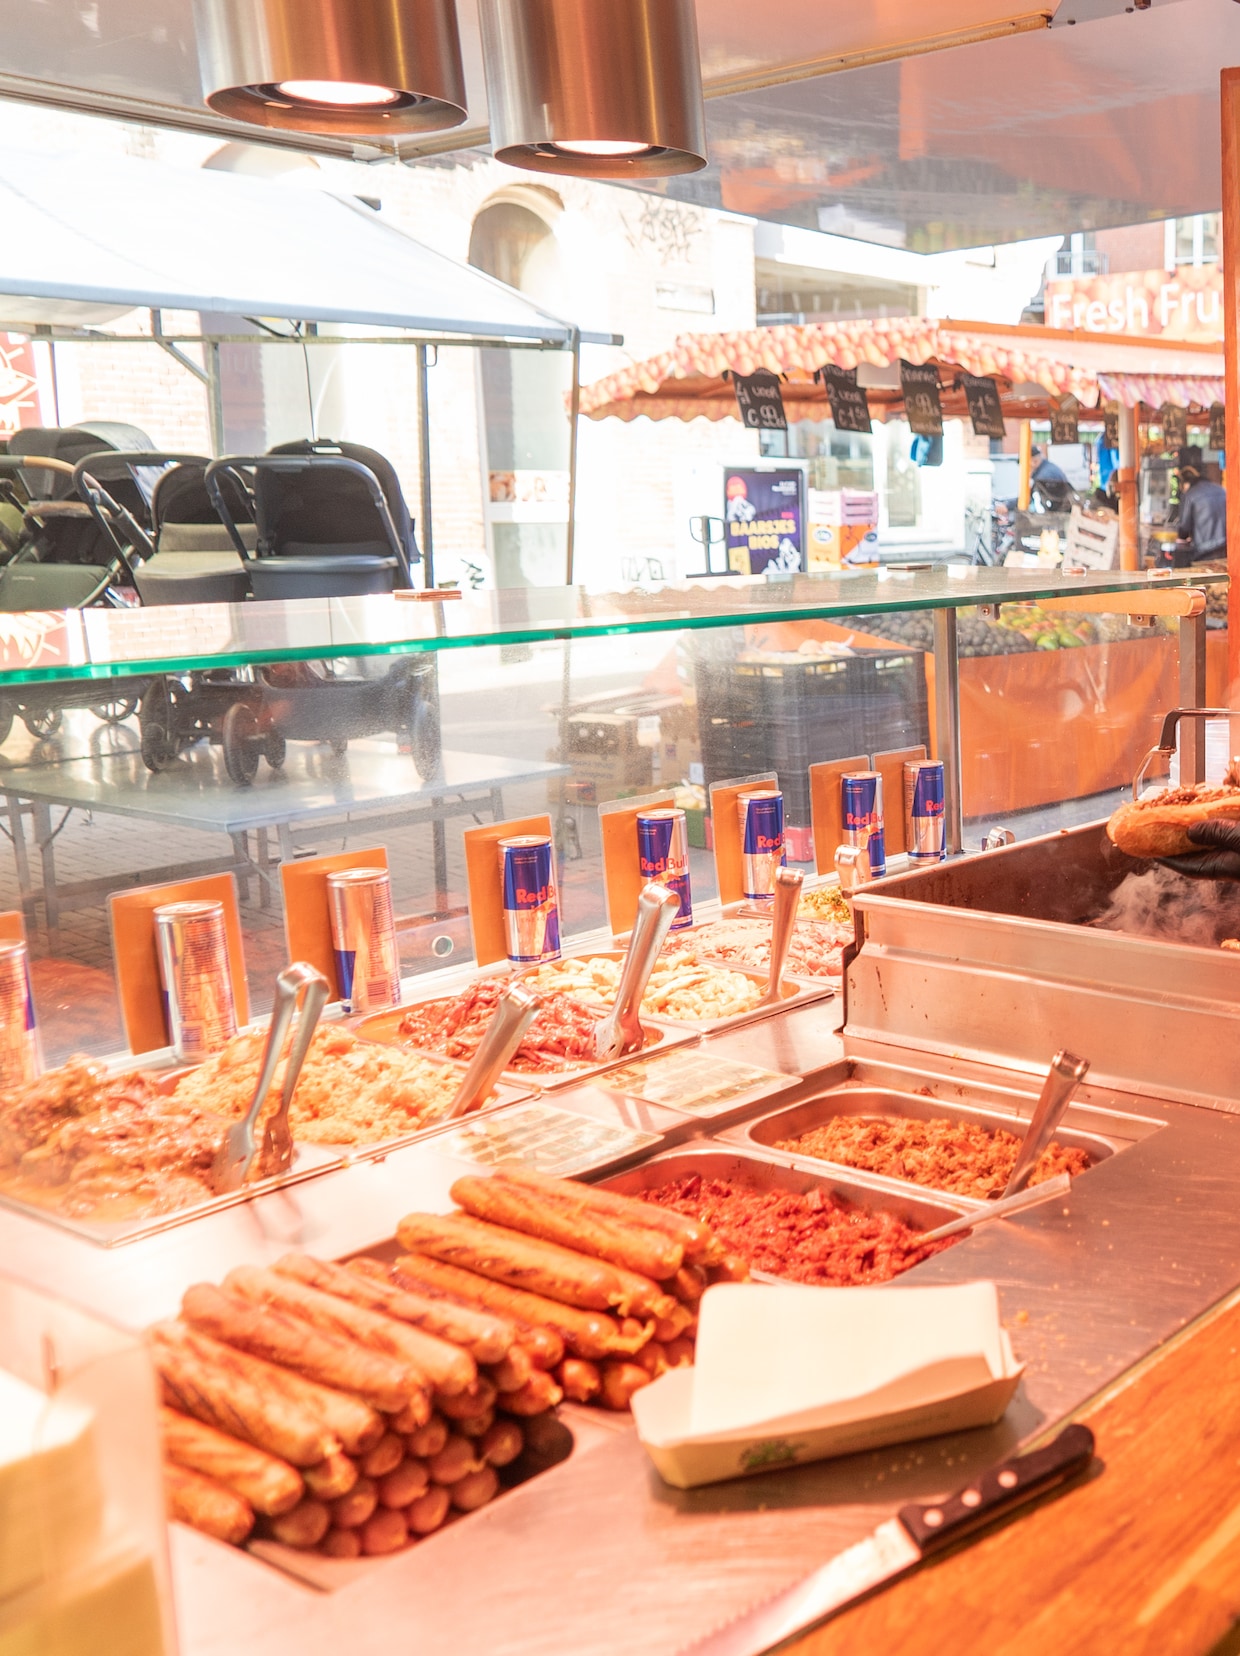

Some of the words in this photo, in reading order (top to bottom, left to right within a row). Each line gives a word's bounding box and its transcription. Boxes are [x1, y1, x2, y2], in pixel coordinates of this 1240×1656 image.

[1051, 284, 1149, 333] Fresh
[1160, 283, 1221, 328] Fru
[846, 812, 870, 825] Red
[756, 835, 782, 848] Red
[640, 857, 666, 872] Red
[515, 885, 547, 904] Red
